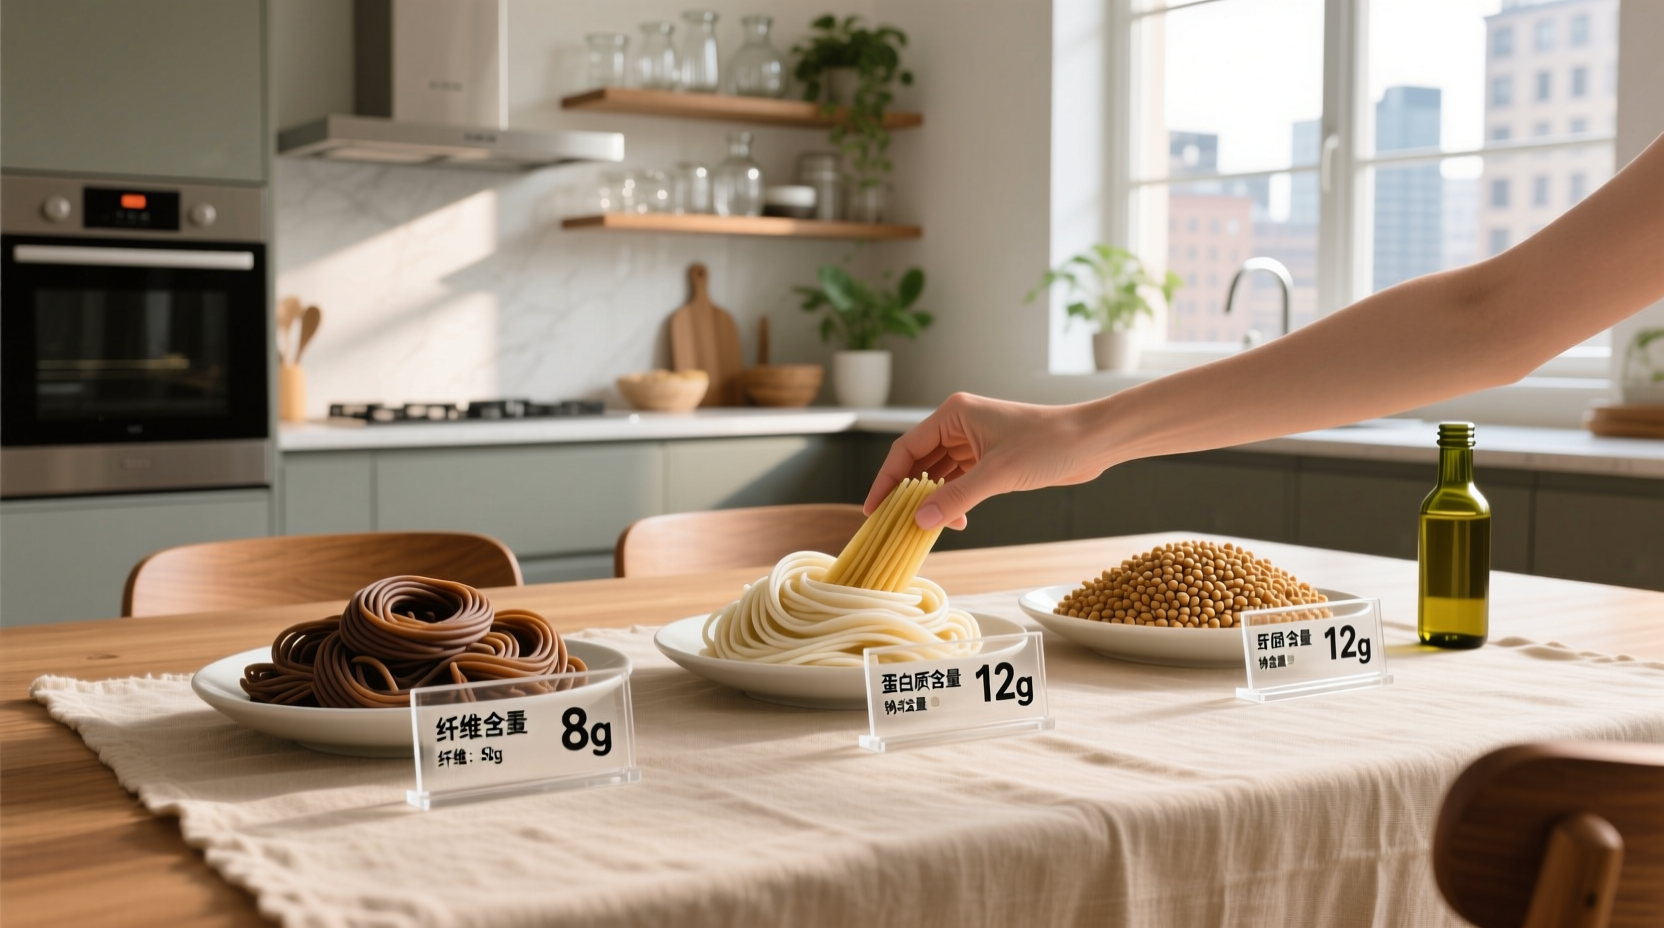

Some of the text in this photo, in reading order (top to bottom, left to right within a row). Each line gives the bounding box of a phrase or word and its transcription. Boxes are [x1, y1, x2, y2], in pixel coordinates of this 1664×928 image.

[1324, 625, 1371, 664] 12g
[881, 668, 961, 694] 蛋白质含量
[975, 662, 1034, 706] 12g
[436, 710, 528, 742] 纤维含量
[561, 707, 612, 756] 8g
